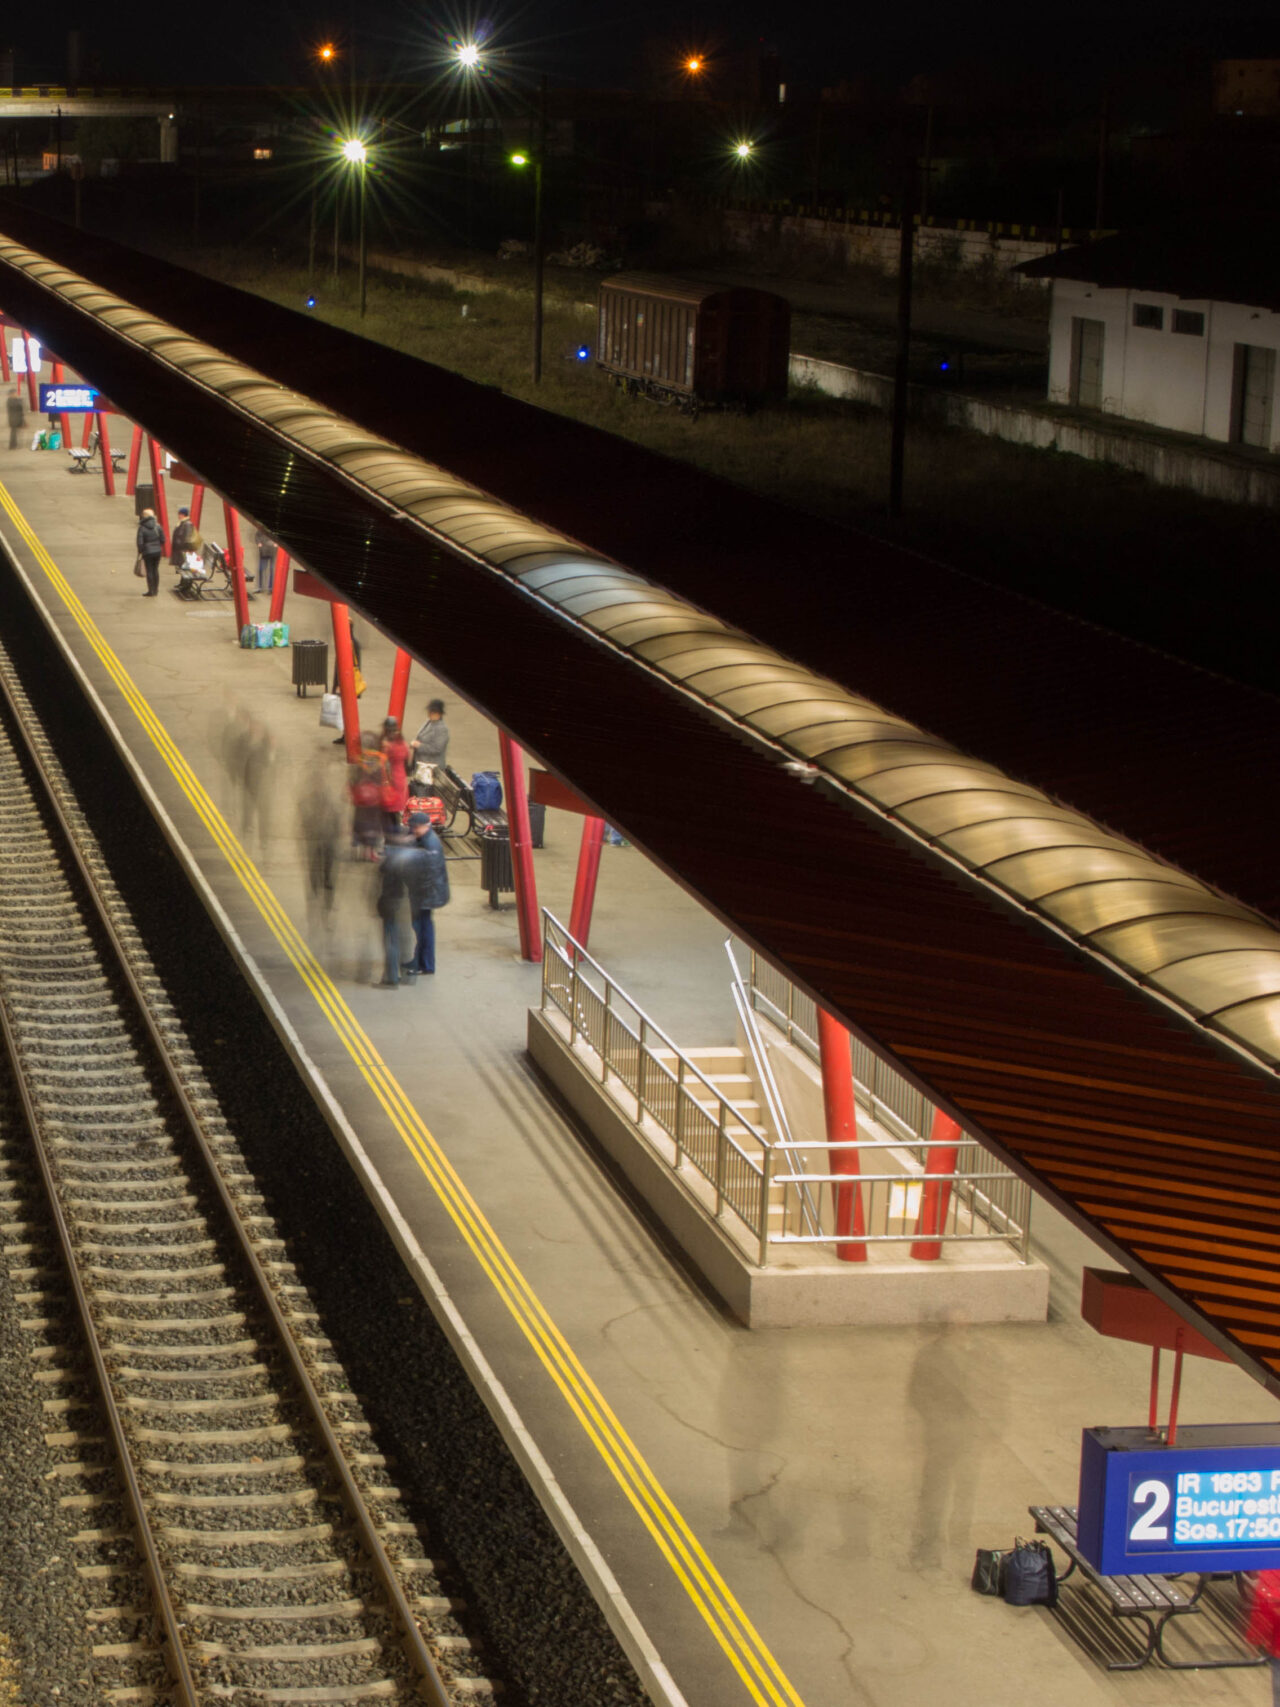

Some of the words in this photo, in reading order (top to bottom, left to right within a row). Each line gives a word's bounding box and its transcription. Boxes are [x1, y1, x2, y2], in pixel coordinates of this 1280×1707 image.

[46, 390, 56, 407] 2
[1177, 1472, 1201, 1494] IR
[1210, 1471, 1262, 1493] 1663
[1129, 1480, 1170, 1540] 2
